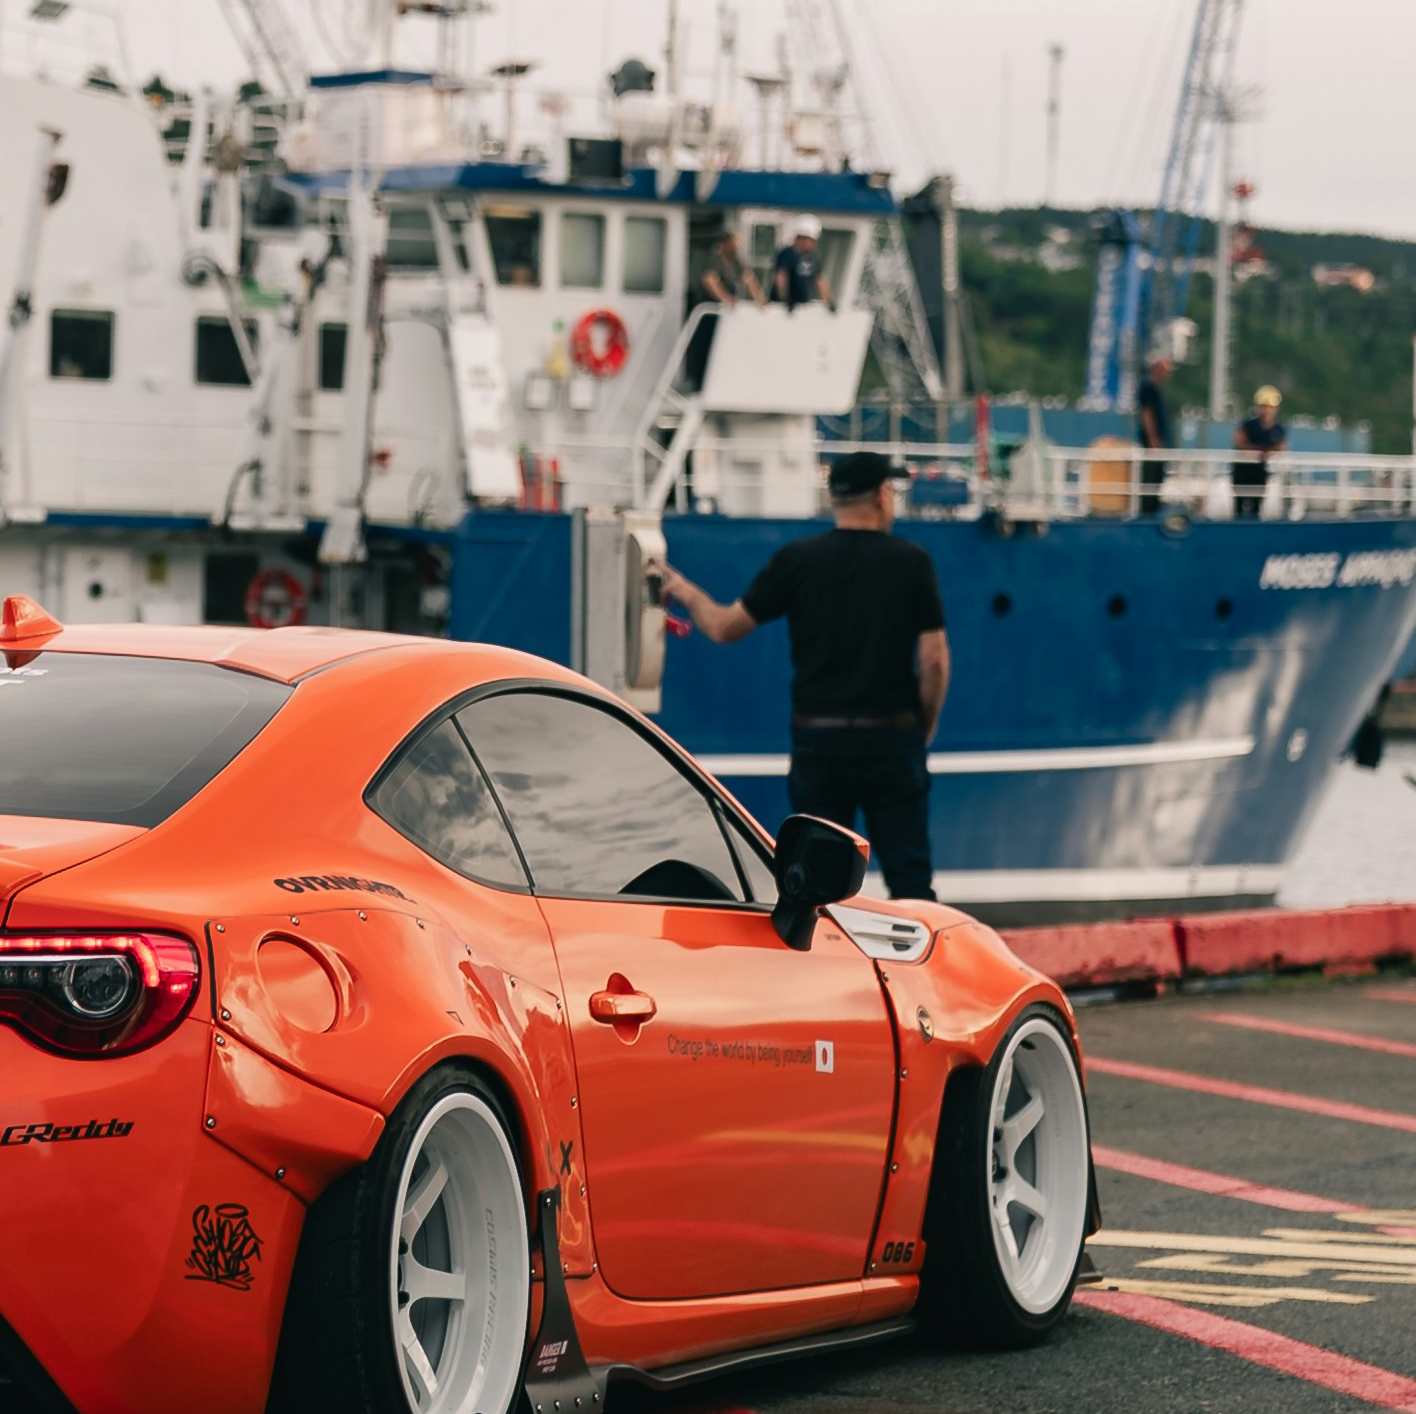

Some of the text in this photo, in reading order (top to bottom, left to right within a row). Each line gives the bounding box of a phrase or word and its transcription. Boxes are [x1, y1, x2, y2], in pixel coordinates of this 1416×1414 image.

[667, 1034, 703, 1060] Change
[705, 1040, 719, 1058] the
[721, 1042, 744, 1062] world
[745, 1043, 757, 1065] by
[757, 1045, 780, 1067] being
[0, 1118, 135, 1146] GReddy
[882, 1241, 915, 1263] 086
